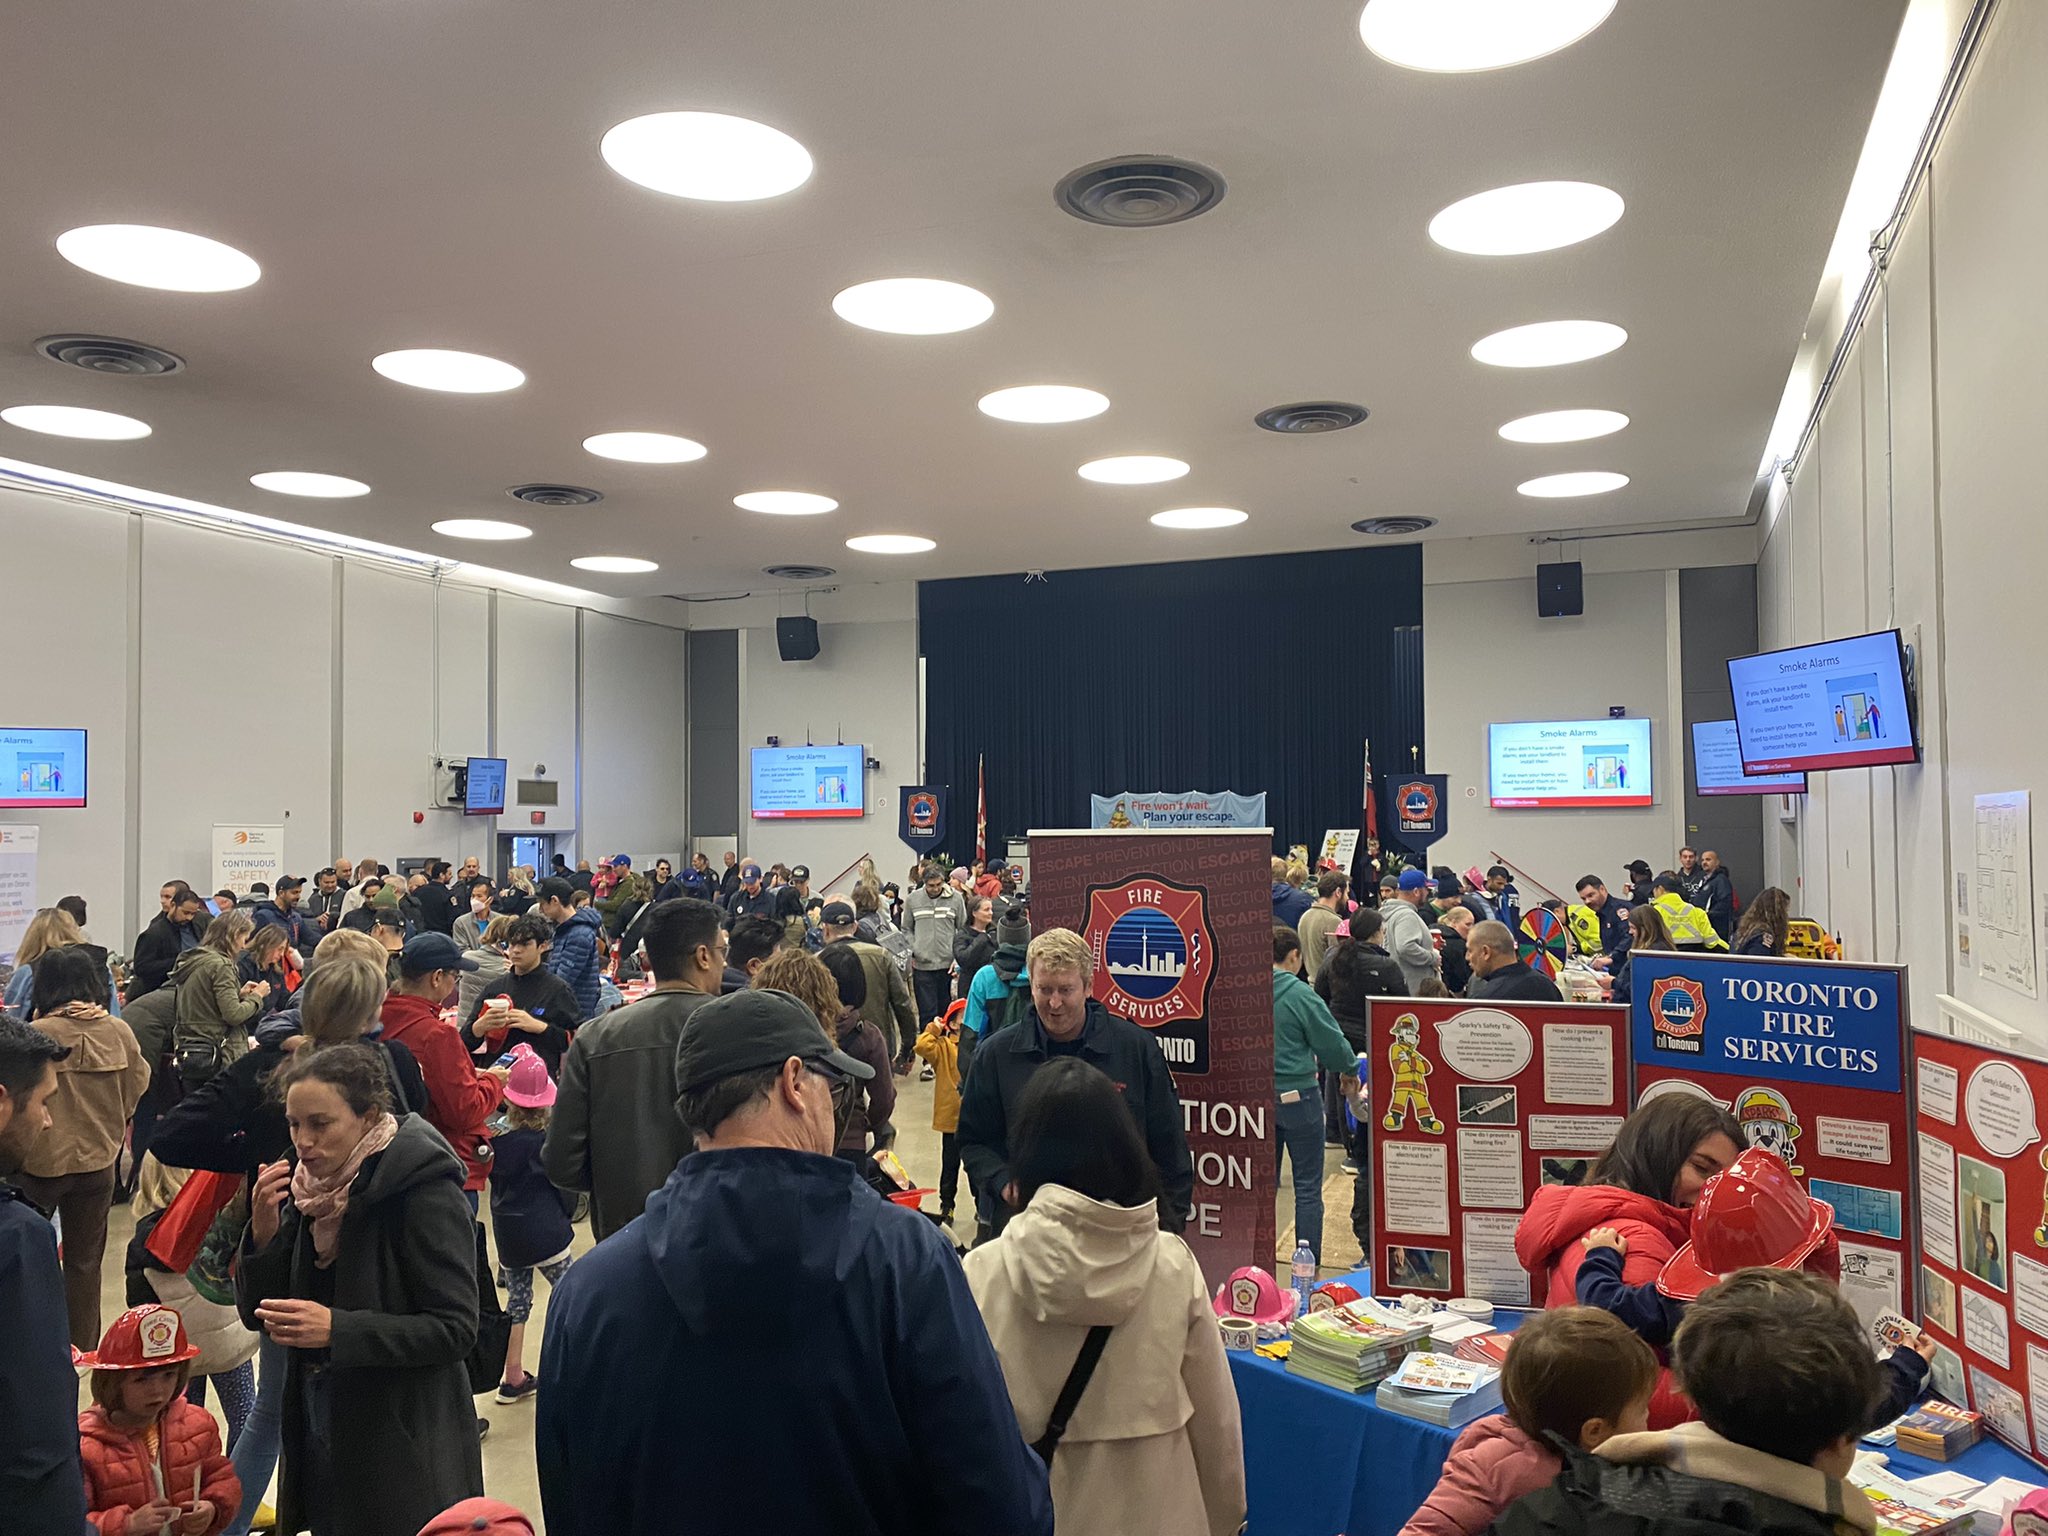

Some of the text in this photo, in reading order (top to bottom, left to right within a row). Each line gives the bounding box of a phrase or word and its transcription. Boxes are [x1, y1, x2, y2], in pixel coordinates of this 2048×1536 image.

[1779, 656, 1840, 674] Smoke Alarms
[1750, 690, 1760, 698] you
[1760, 686, 1774, 696] don't
[1774, 685, 1786, 694] have
[1790, 682, 1807, 691] smoke
[1770, 696, 1782, 705] your
[1782, 692, 1804, 702] landlord
[1779, 704, 1793, 712] them
[1540, 730, 1567, 738] Smoke
[1788, 722, 1803, 730] home,
[1750, 734, 1762, 743] need
[1769, 732, 1782, 740] install
[1784, 732, 1798, 740] them
[1132, 800, 1212, 811] Fire won't wait.
[1144, 812, 1236, 823] Plan your escape.
[1038, 839, 1183, 874] ESCAPE PREVENTION
[1198, 848, 1262, 870] ESCAPE
[230, 870, 270, 880] SAFETY
[224, 882, 275, 894] SERVS
[1045, 894, 1085, 912] DETEC
[1127, 888, 1163, 905] FIRE
[1044, 888, 1272, 929] ESCA TECTION
[1212, 909, 1270, 928] SCAPE
[1722, 978, 1878, 1011] TORONTO
[1109, 992, 1184, 1019] SERVICES
[1662, 1022, 1695, 1034] SERVICES
[1762, 1010, 1836, 1038] FIRE
[1667, 1036, 1700, 1052] TORONTO
[1724, 1036, 1879, 1073] SERVICES
[1179, 1099, 1265, 1140] TION
[1744, 1106, 1781, 1120] SPARKY
[1822, 1121, 1846, 1129] Develop
[1190, 1150, 1252, 1190] ON
[1922, 1400, 1974, 1422] FIRE
